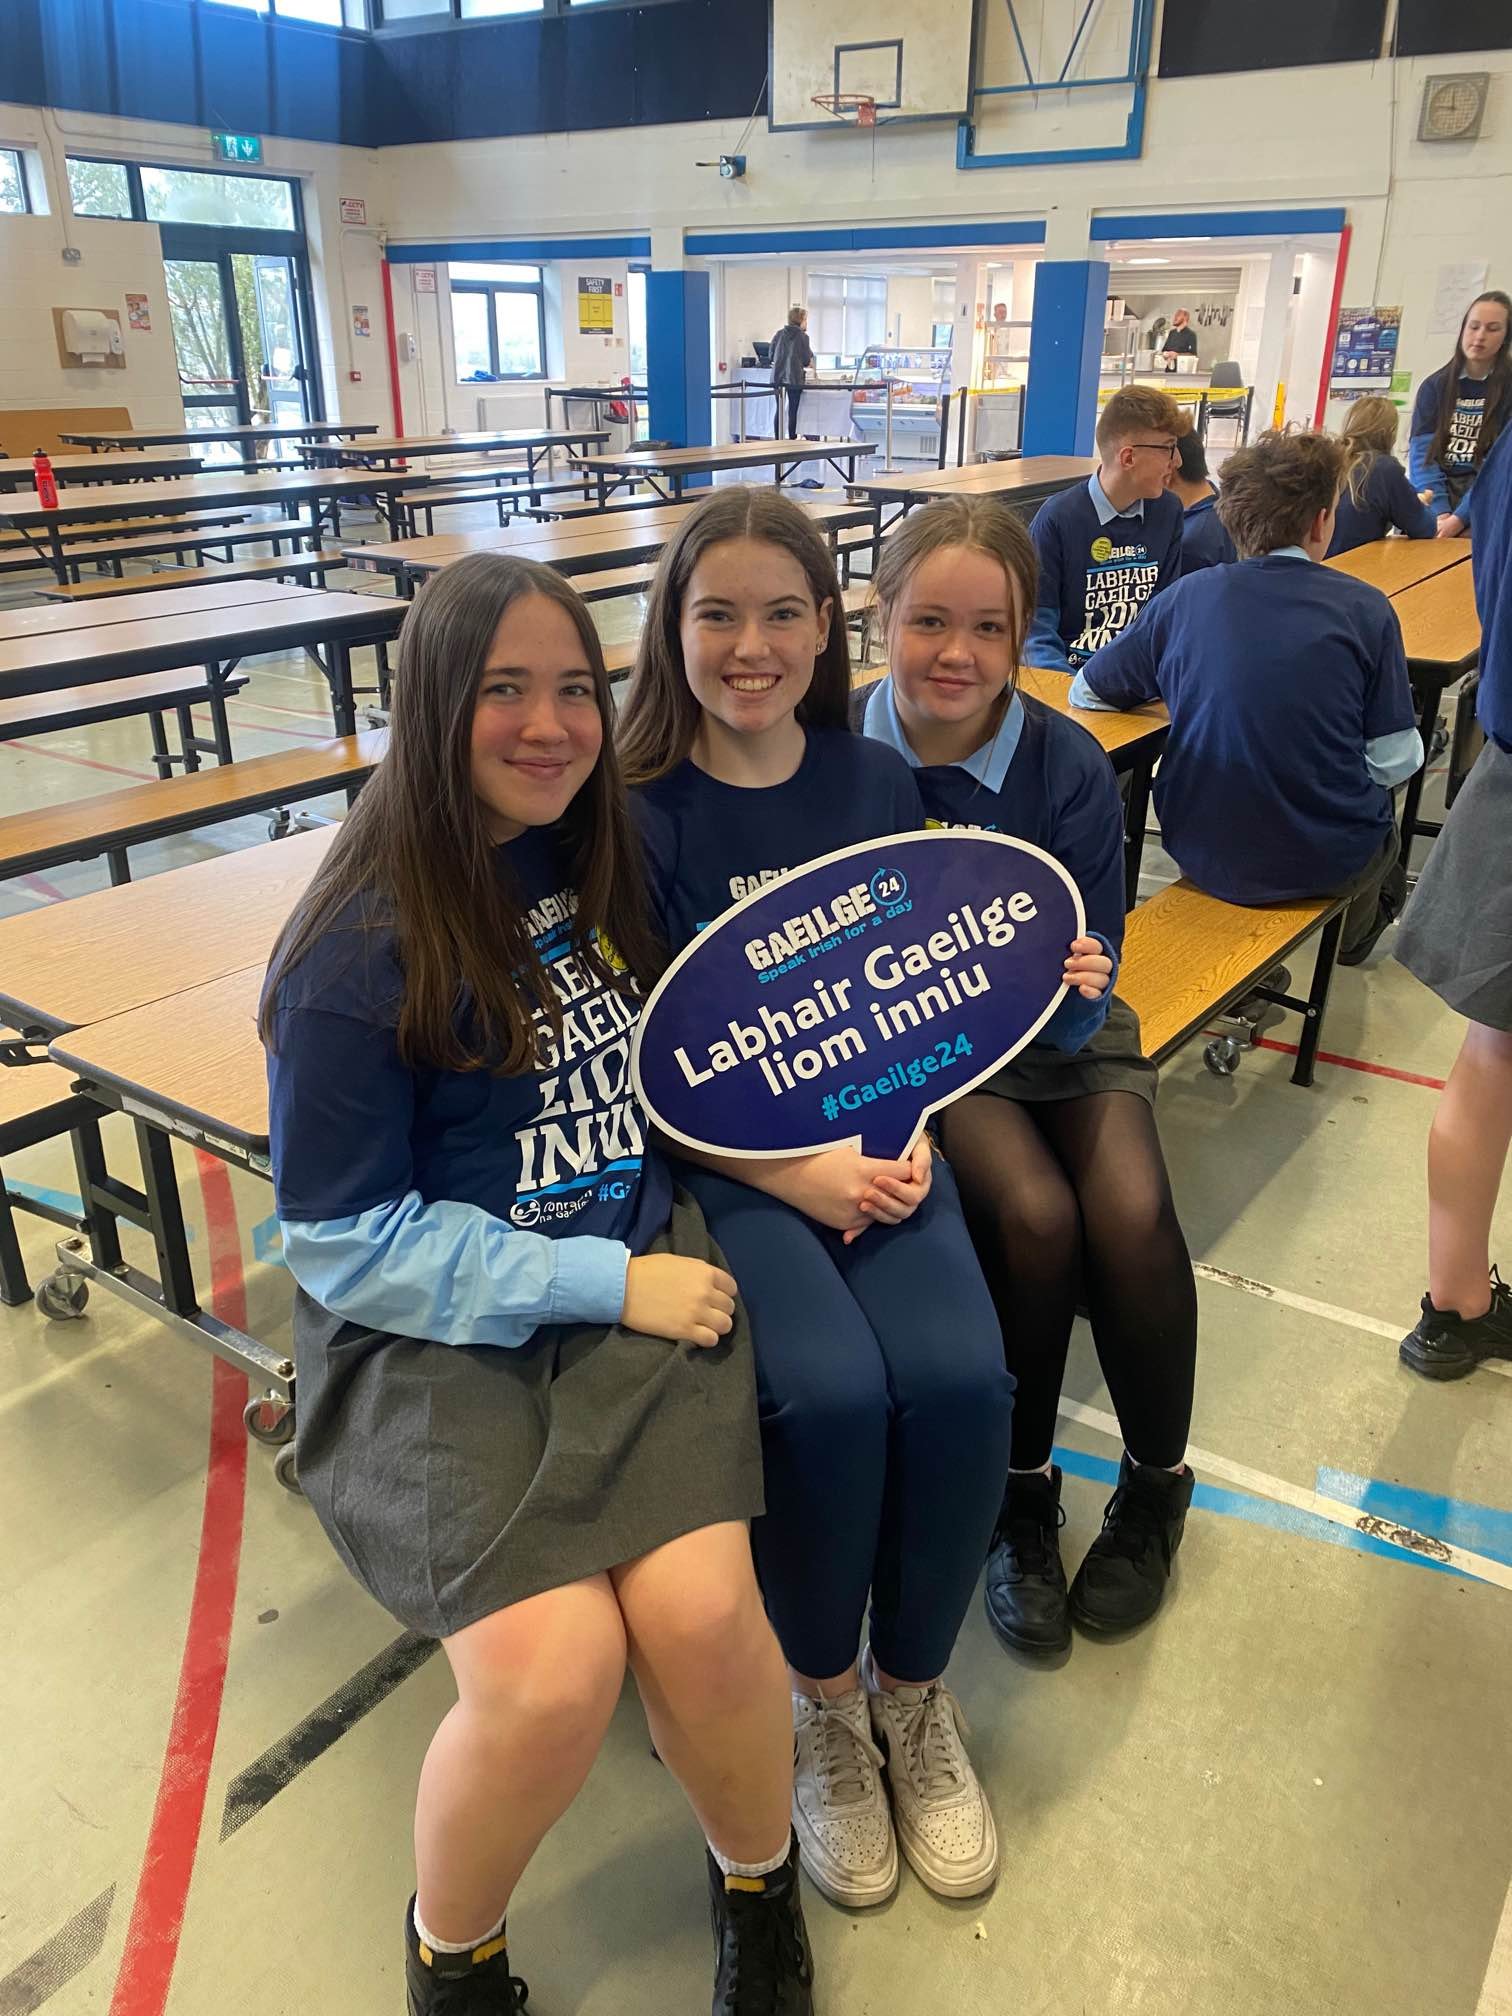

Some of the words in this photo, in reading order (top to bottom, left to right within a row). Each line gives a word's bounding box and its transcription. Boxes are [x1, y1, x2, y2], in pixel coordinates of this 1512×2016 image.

[585, 278, 605, 286] SAFETY
[1086, 566, 1159, 591] LABHAIR
[729, 867, 788, 901] GAE
[744, 883, 877, 971] GAEILGE
[878, 876, 901, 898] 24
[758, 953, 807, 984] Speak
[807, 935, 843, 959] Irish
[844, 922, 868, 940] for
[871, 916, 883, 927] a
[886, 899, 914, 919] day
[673, 979, 853, 1088] Labhair
[864, 891, 1039, 990] Gaeilge
[758, 1024, 867, 1097] liom
[869, 963, 992, 1041] inniu
[821, 1033, 974, 1121] #Gaeilge24
